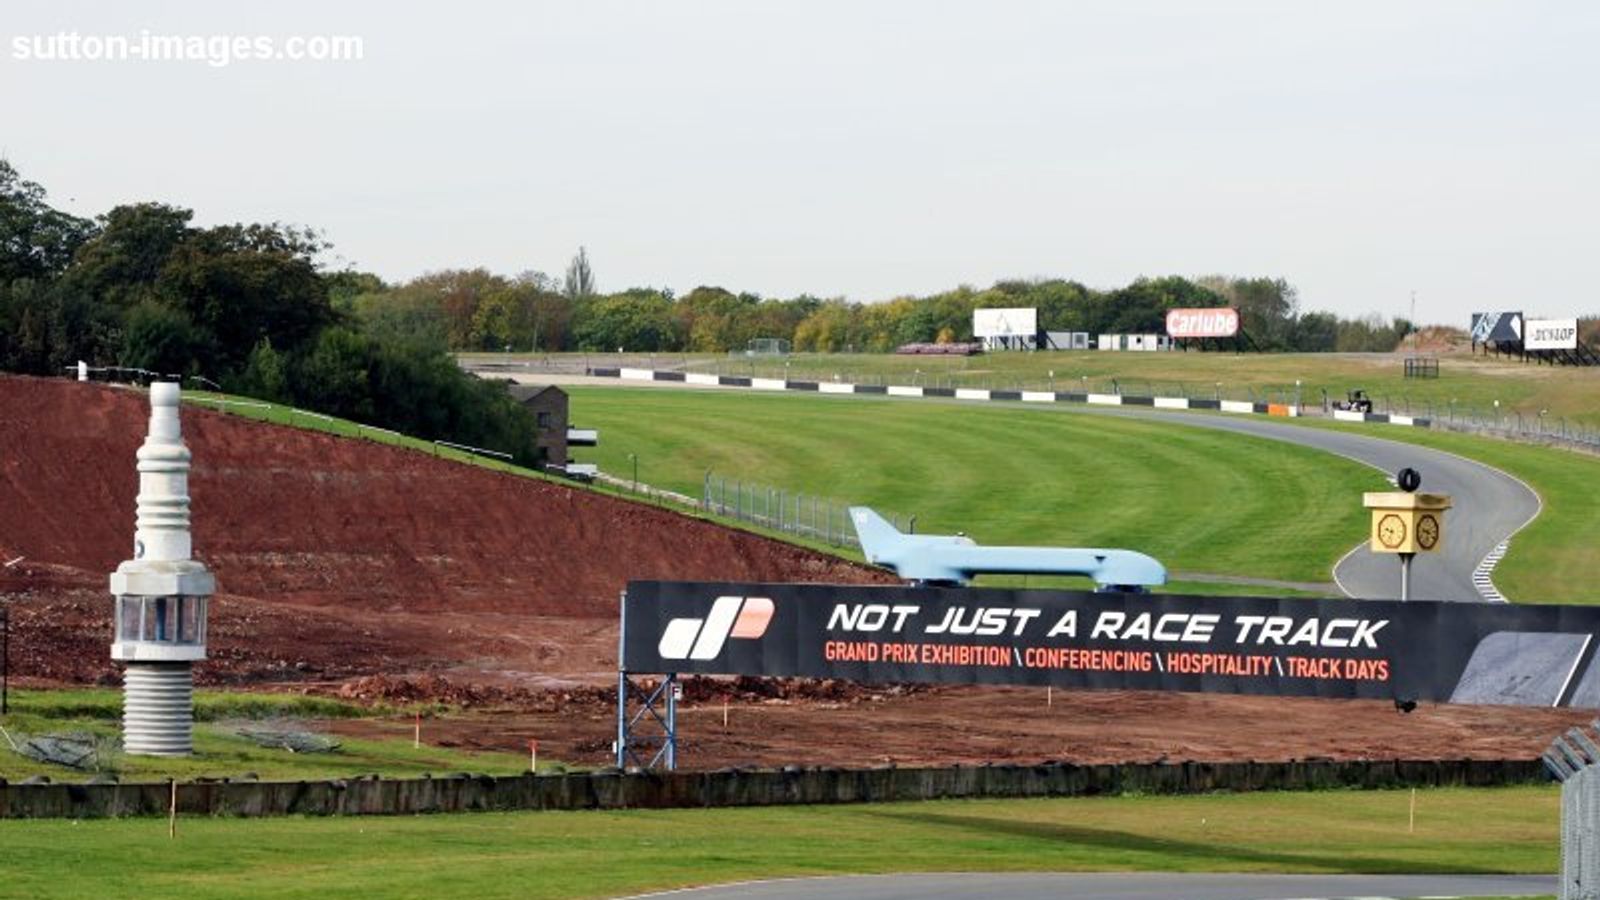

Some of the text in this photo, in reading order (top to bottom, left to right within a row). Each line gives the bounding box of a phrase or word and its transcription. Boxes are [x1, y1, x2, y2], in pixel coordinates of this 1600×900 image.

[1167, 309, 1236, 334] Carlube
[827, 603, 1389, 648] NOT JUST A RACE TRACK
[825, 641, 880, 661] GRAND
[882, 642, 919, 663] PRIX
[921, 645, 1012, 667] EXHIBITION
[1025, 648, 1152, 672] CONFERENCING
[1167, 652, 1272, 676] HOSPITALITY
[1288, 656, 1341, 680] TRACK
[1344, 659, 1390, 682] DAYS
